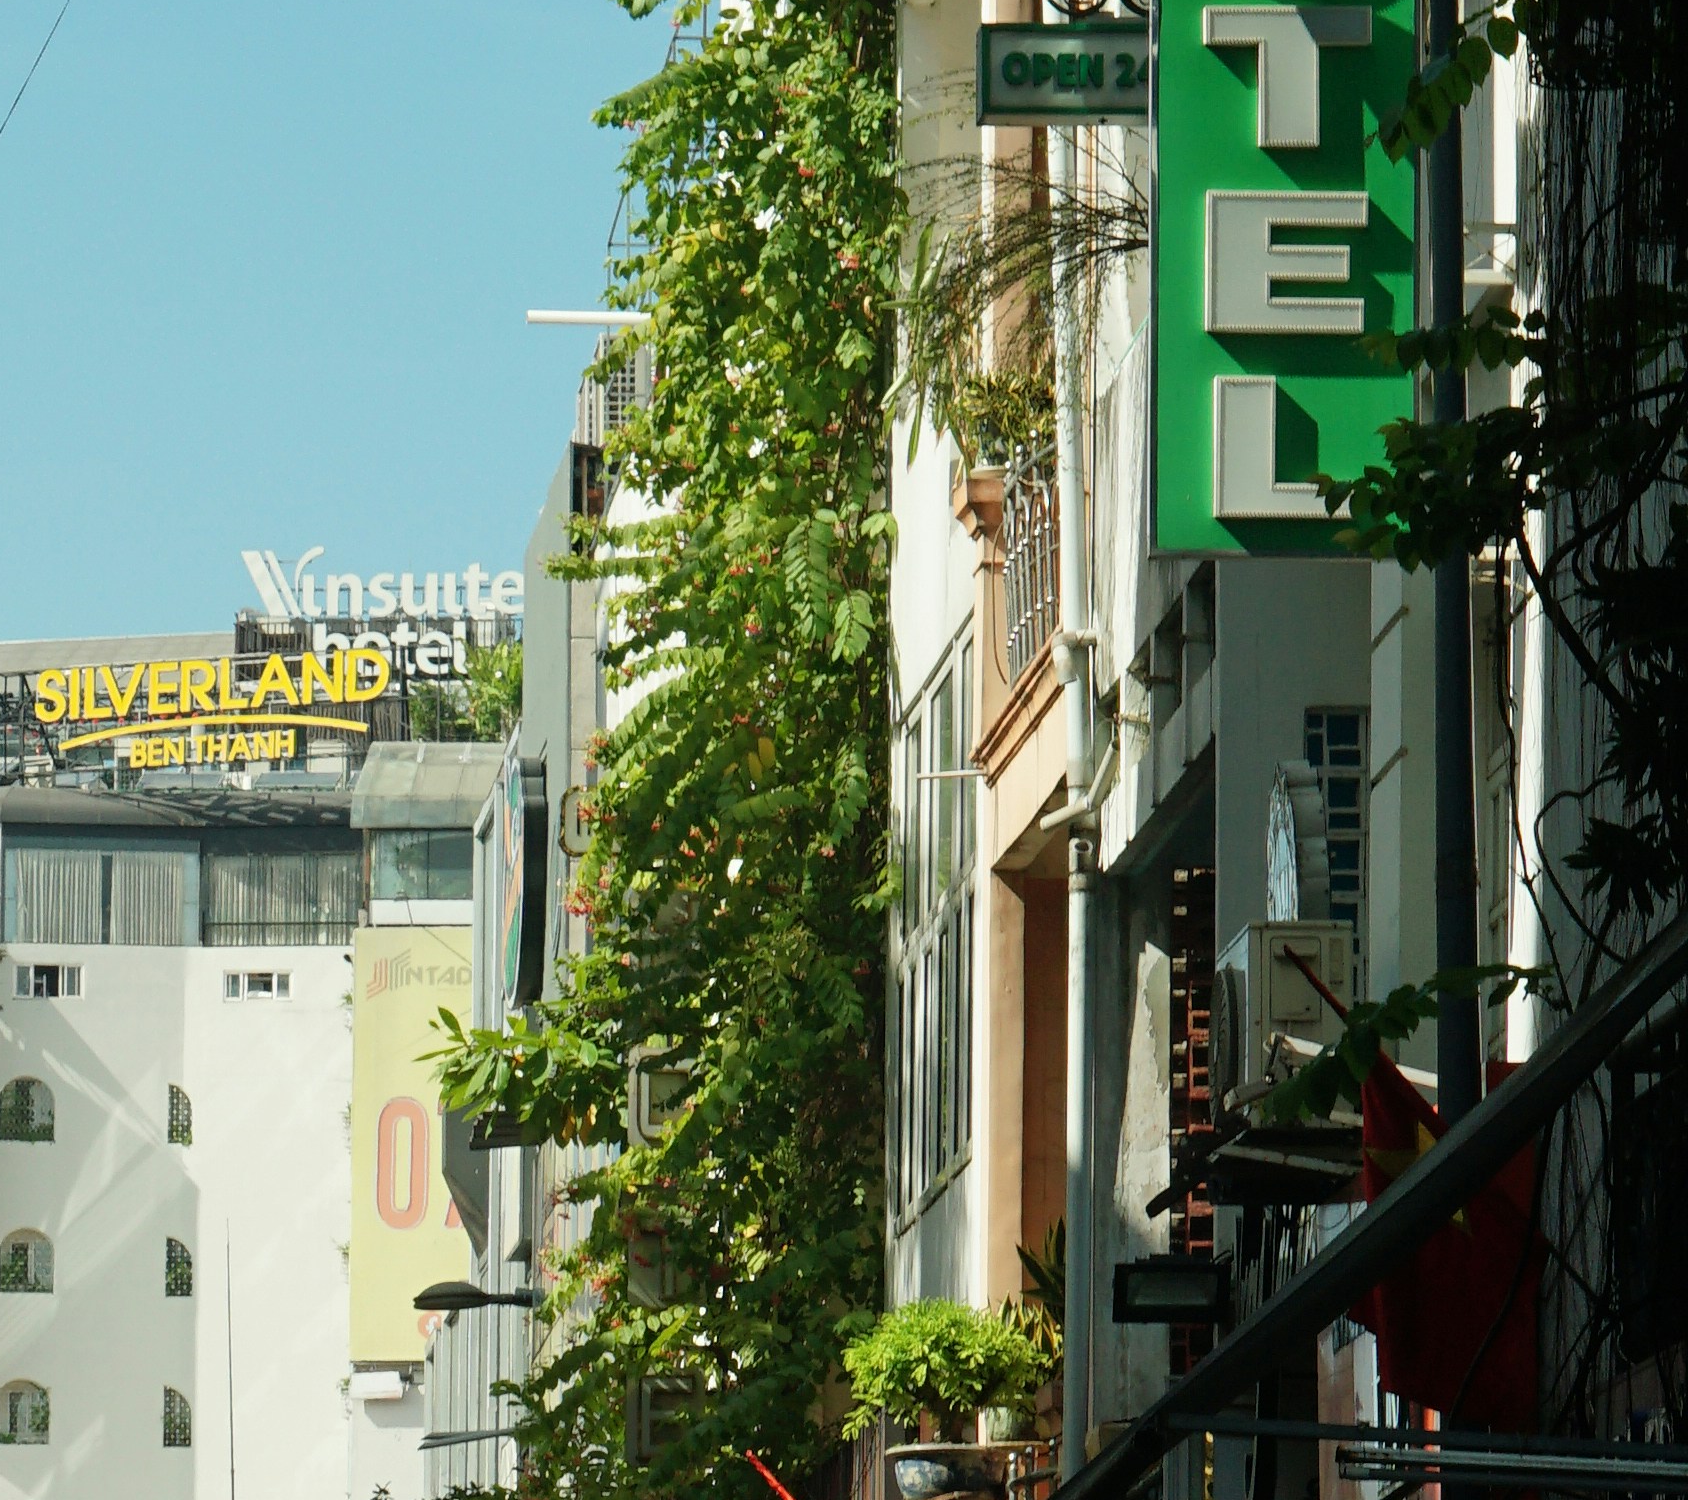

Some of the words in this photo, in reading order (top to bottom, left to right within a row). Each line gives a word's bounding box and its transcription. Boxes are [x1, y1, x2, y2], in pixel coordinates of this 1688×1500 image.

[1001, 50, 1105, 88] OPEN
[240, 545, 524, 619] Vinsuite
[313, 620, 468, 678] hotel
[34, 647, 390, 723] SILVERLAND
[129, 737, 186, 770] BEN
[195, 727, 296, 764] THANH
